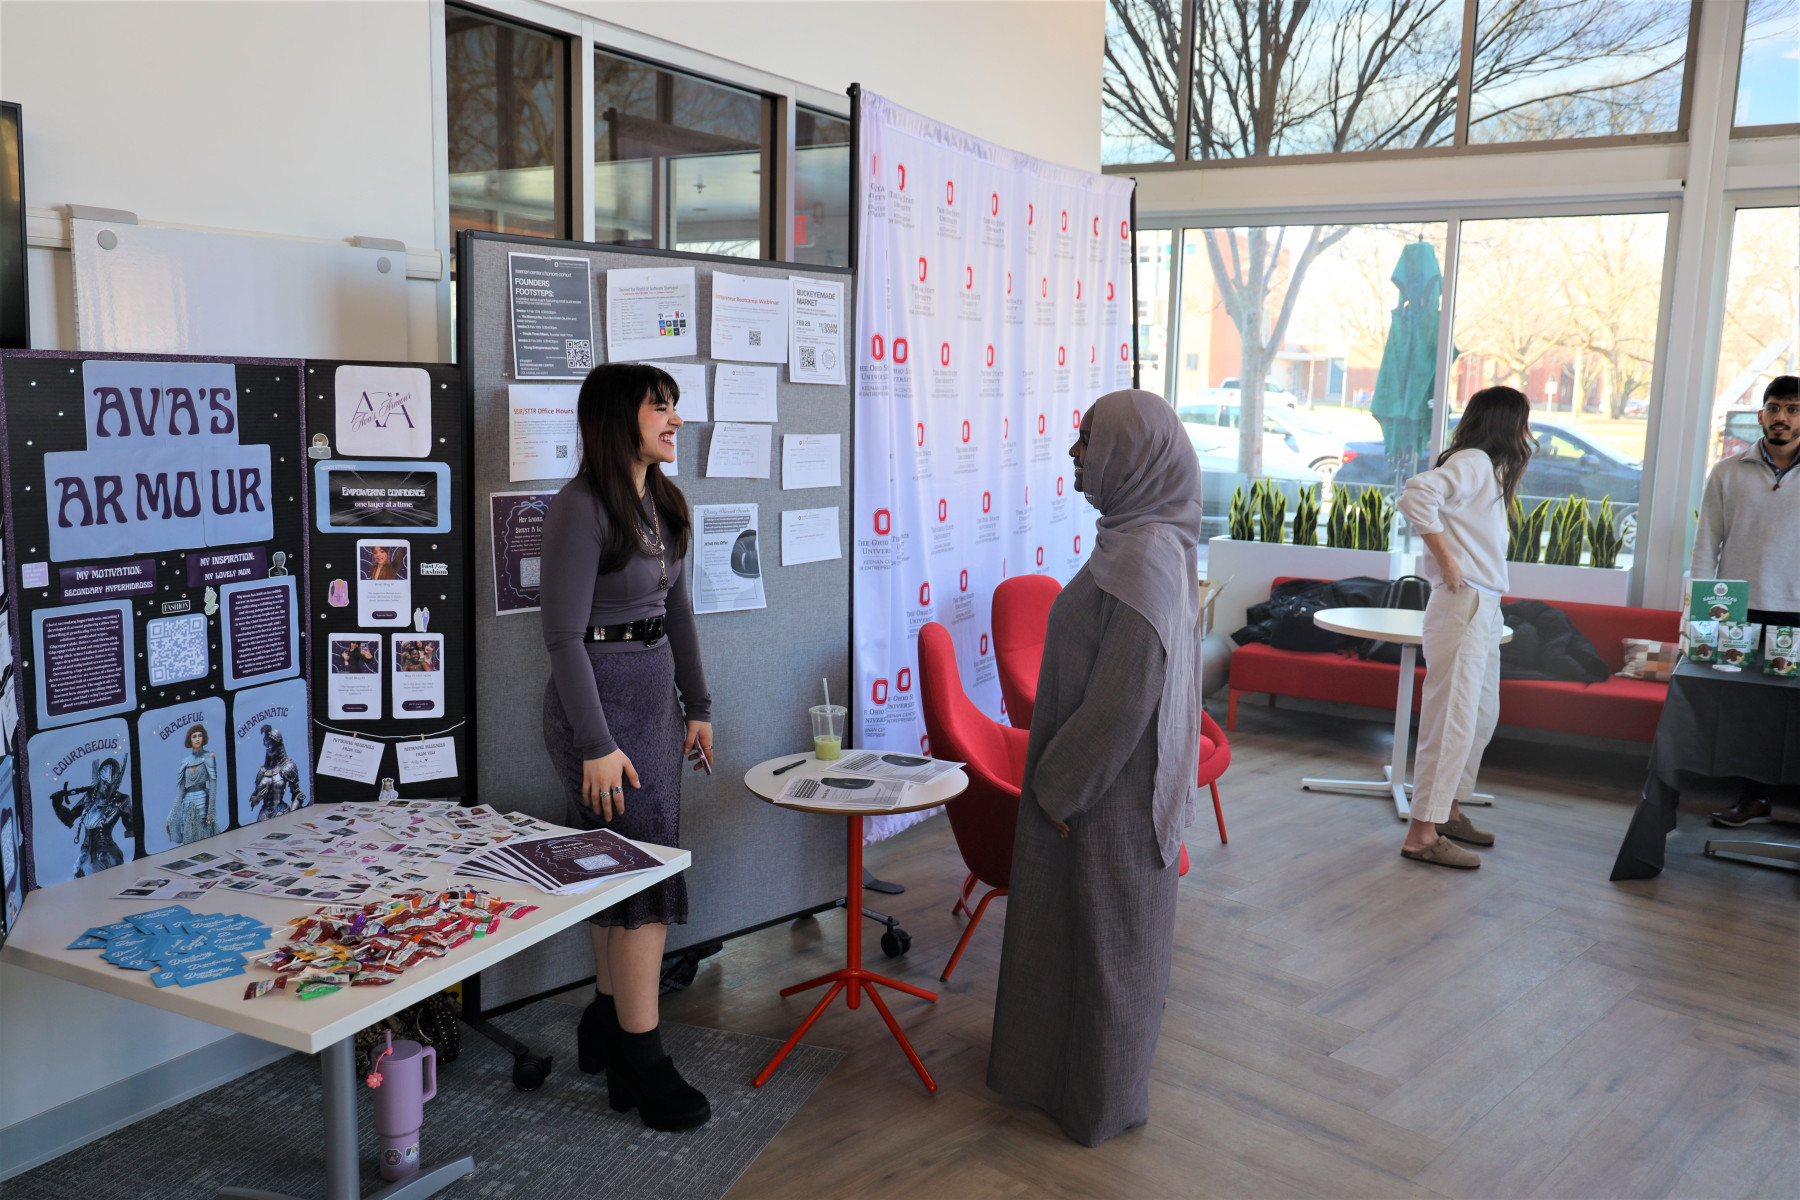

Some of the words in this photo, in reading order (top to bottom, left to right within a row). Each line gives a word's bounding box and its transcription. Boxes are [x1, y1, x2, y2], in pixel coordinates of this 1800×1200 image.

[515, 278, 550, 287] FOUNDERS
[797, 289, 835, 300] BUCKEYEMADE
[797, 298, 818, 307] MARKET
[93, 387, 235, 438] AVA'S
[200, 557, 211, 567] MY
[212, 552, 255, 565] INSPIRATION:
[76, 571, 89, 580] MY
[91, 566, 142, 579] MOTIVATION:
[215, 570, 237, 579] LOVELY
[64, 586, 103, 597] SECONDARY
[105, 581, 153, 592] HYPERHIDROSIS
[160, 711, 204, 741] GRACEFUL
[236, 707, 289, 739] CHARISMATIC
[52, 738, 118, 777] COURAGEOUS
